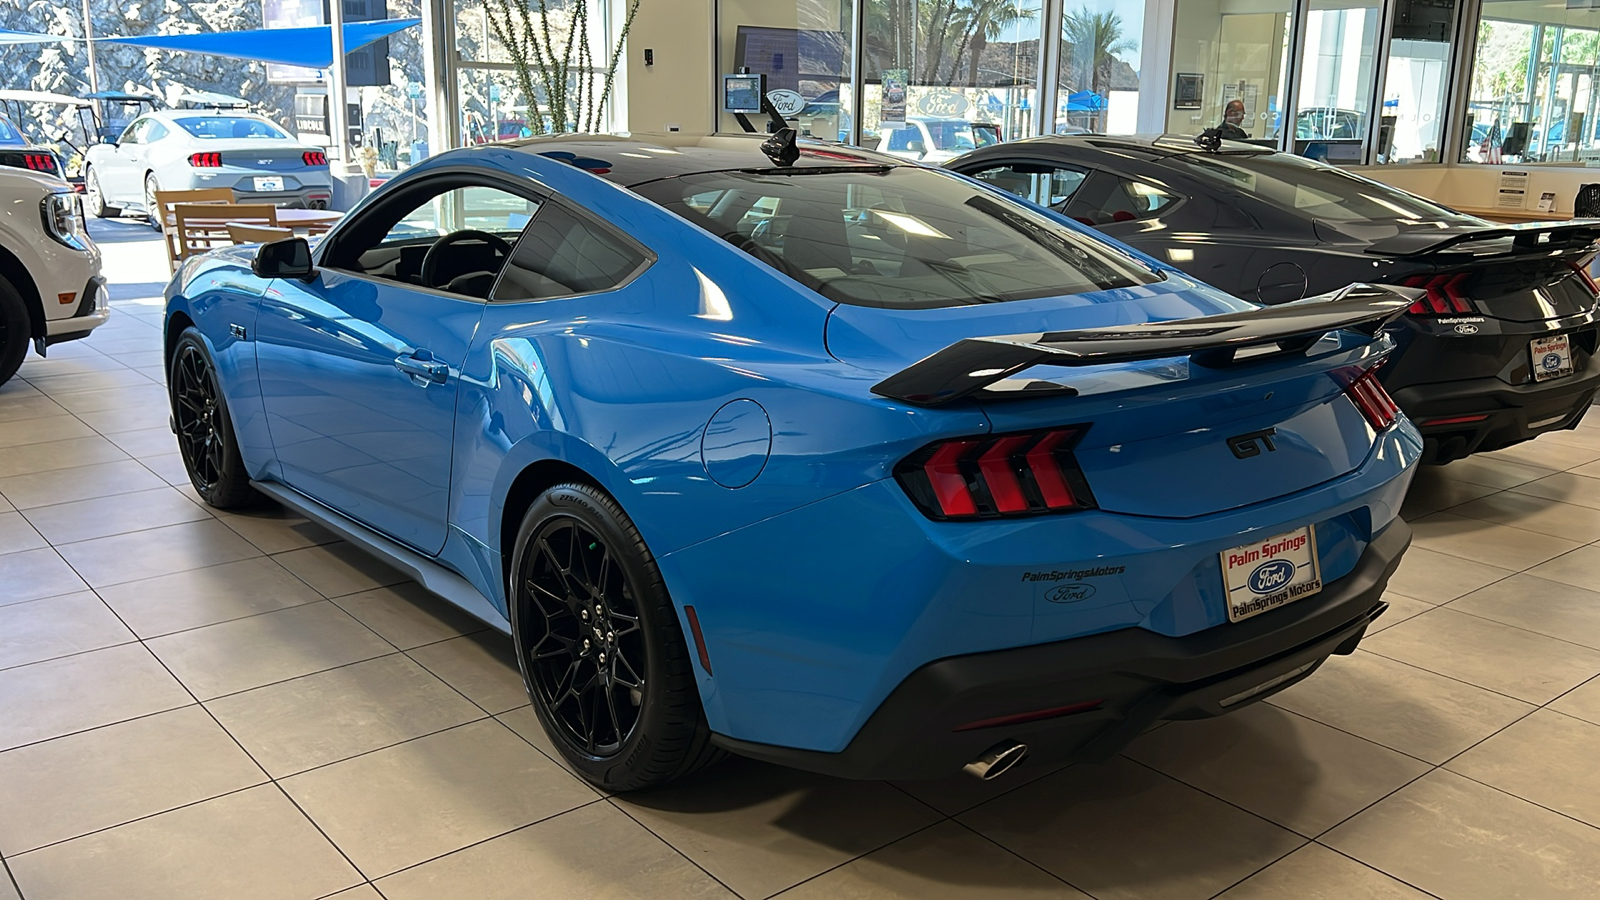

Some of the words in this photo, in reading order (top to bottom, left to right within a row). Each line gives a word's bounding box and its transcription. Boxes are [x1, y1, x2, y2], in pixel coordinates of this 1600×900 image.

[773, 94, 796, 111] Ford
[926, 93, 960, 114] Ford
[1547, 342, 1567, 352] Springs
[1226, 426, 1277, 459] GT
[1229, 550, 1260, 570] Palm
[1262, 535, 1306, 558] Springs
[1022, 565, 1126, 582] PalmSpringsMotors
[1258, 565, 1286, 590] Ford
[1053, 586, 1088, 601] Ford
[1232, 591, 1289, 619] PalmSprings
[1289, 580, 1321, 598] Motors
